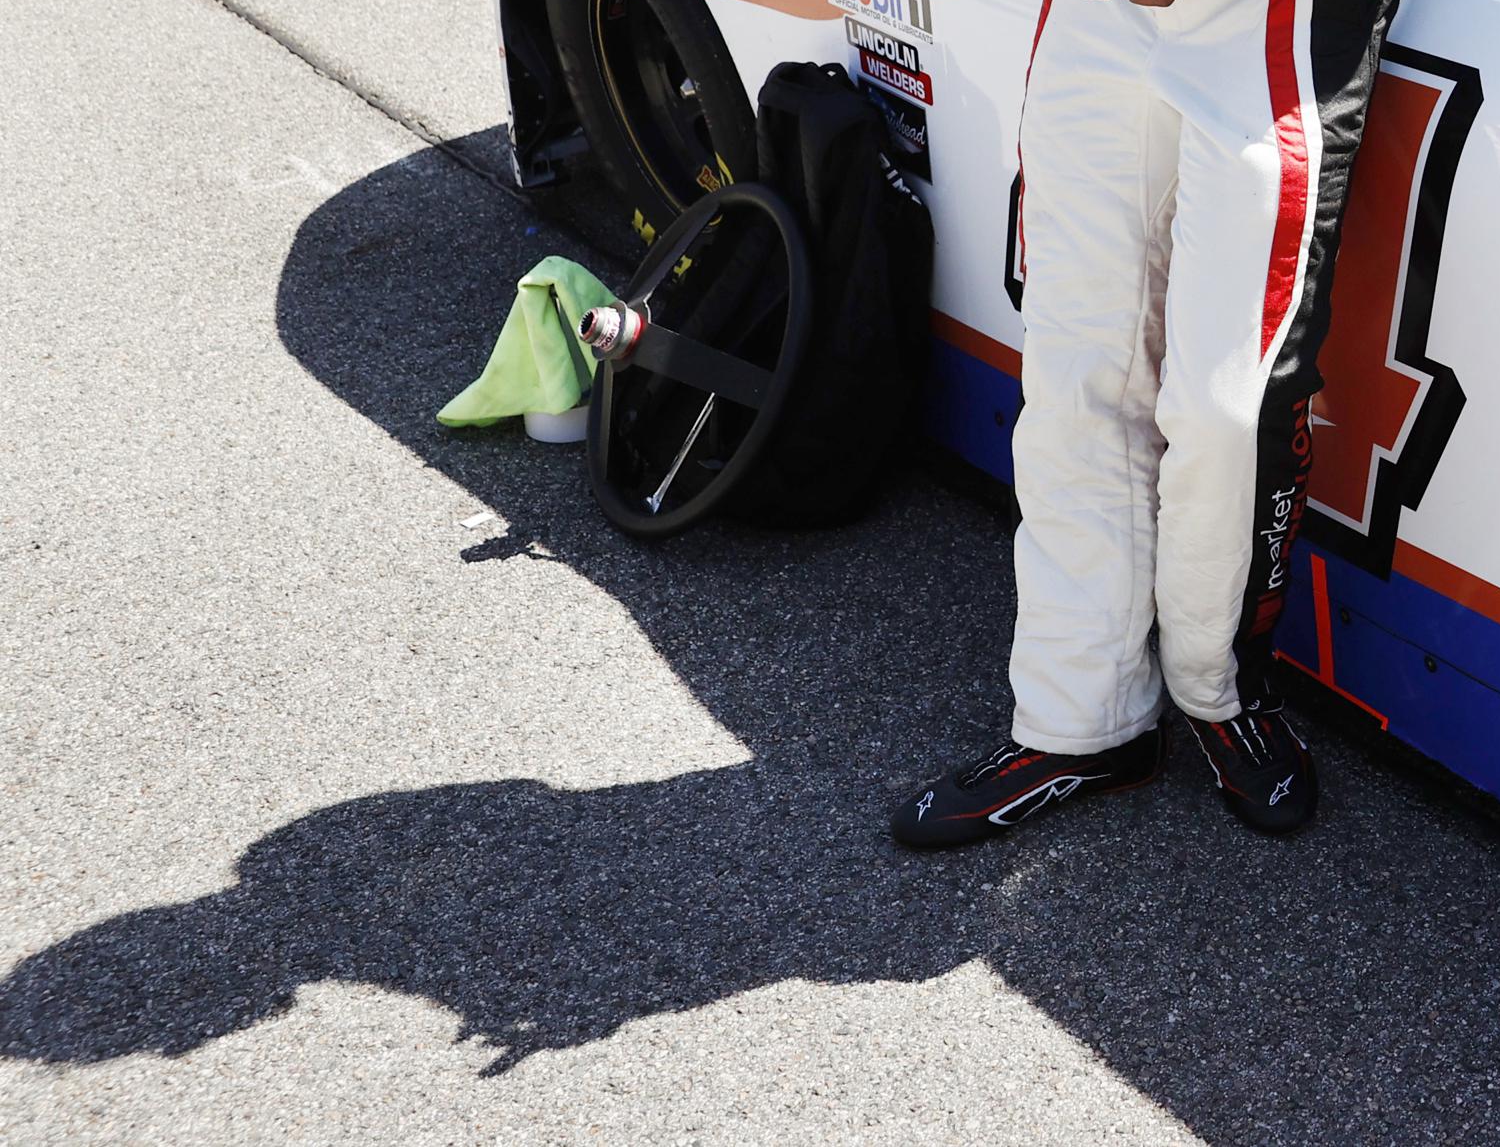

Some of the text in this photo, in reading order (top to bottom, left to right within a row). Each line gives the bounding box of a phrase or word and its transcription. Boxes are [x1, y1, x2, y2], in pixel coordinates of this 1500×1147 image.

[848, 20, 916, 71] LINCOLN
[860, 6, 881, 20] MOTOR
[881, 15, 891, 26] OIL
[898, 23, 934, 45] LUBRICANTS
[865, 56, 926, 100] WELDERS
[1260, 486, 1296, 591] market
